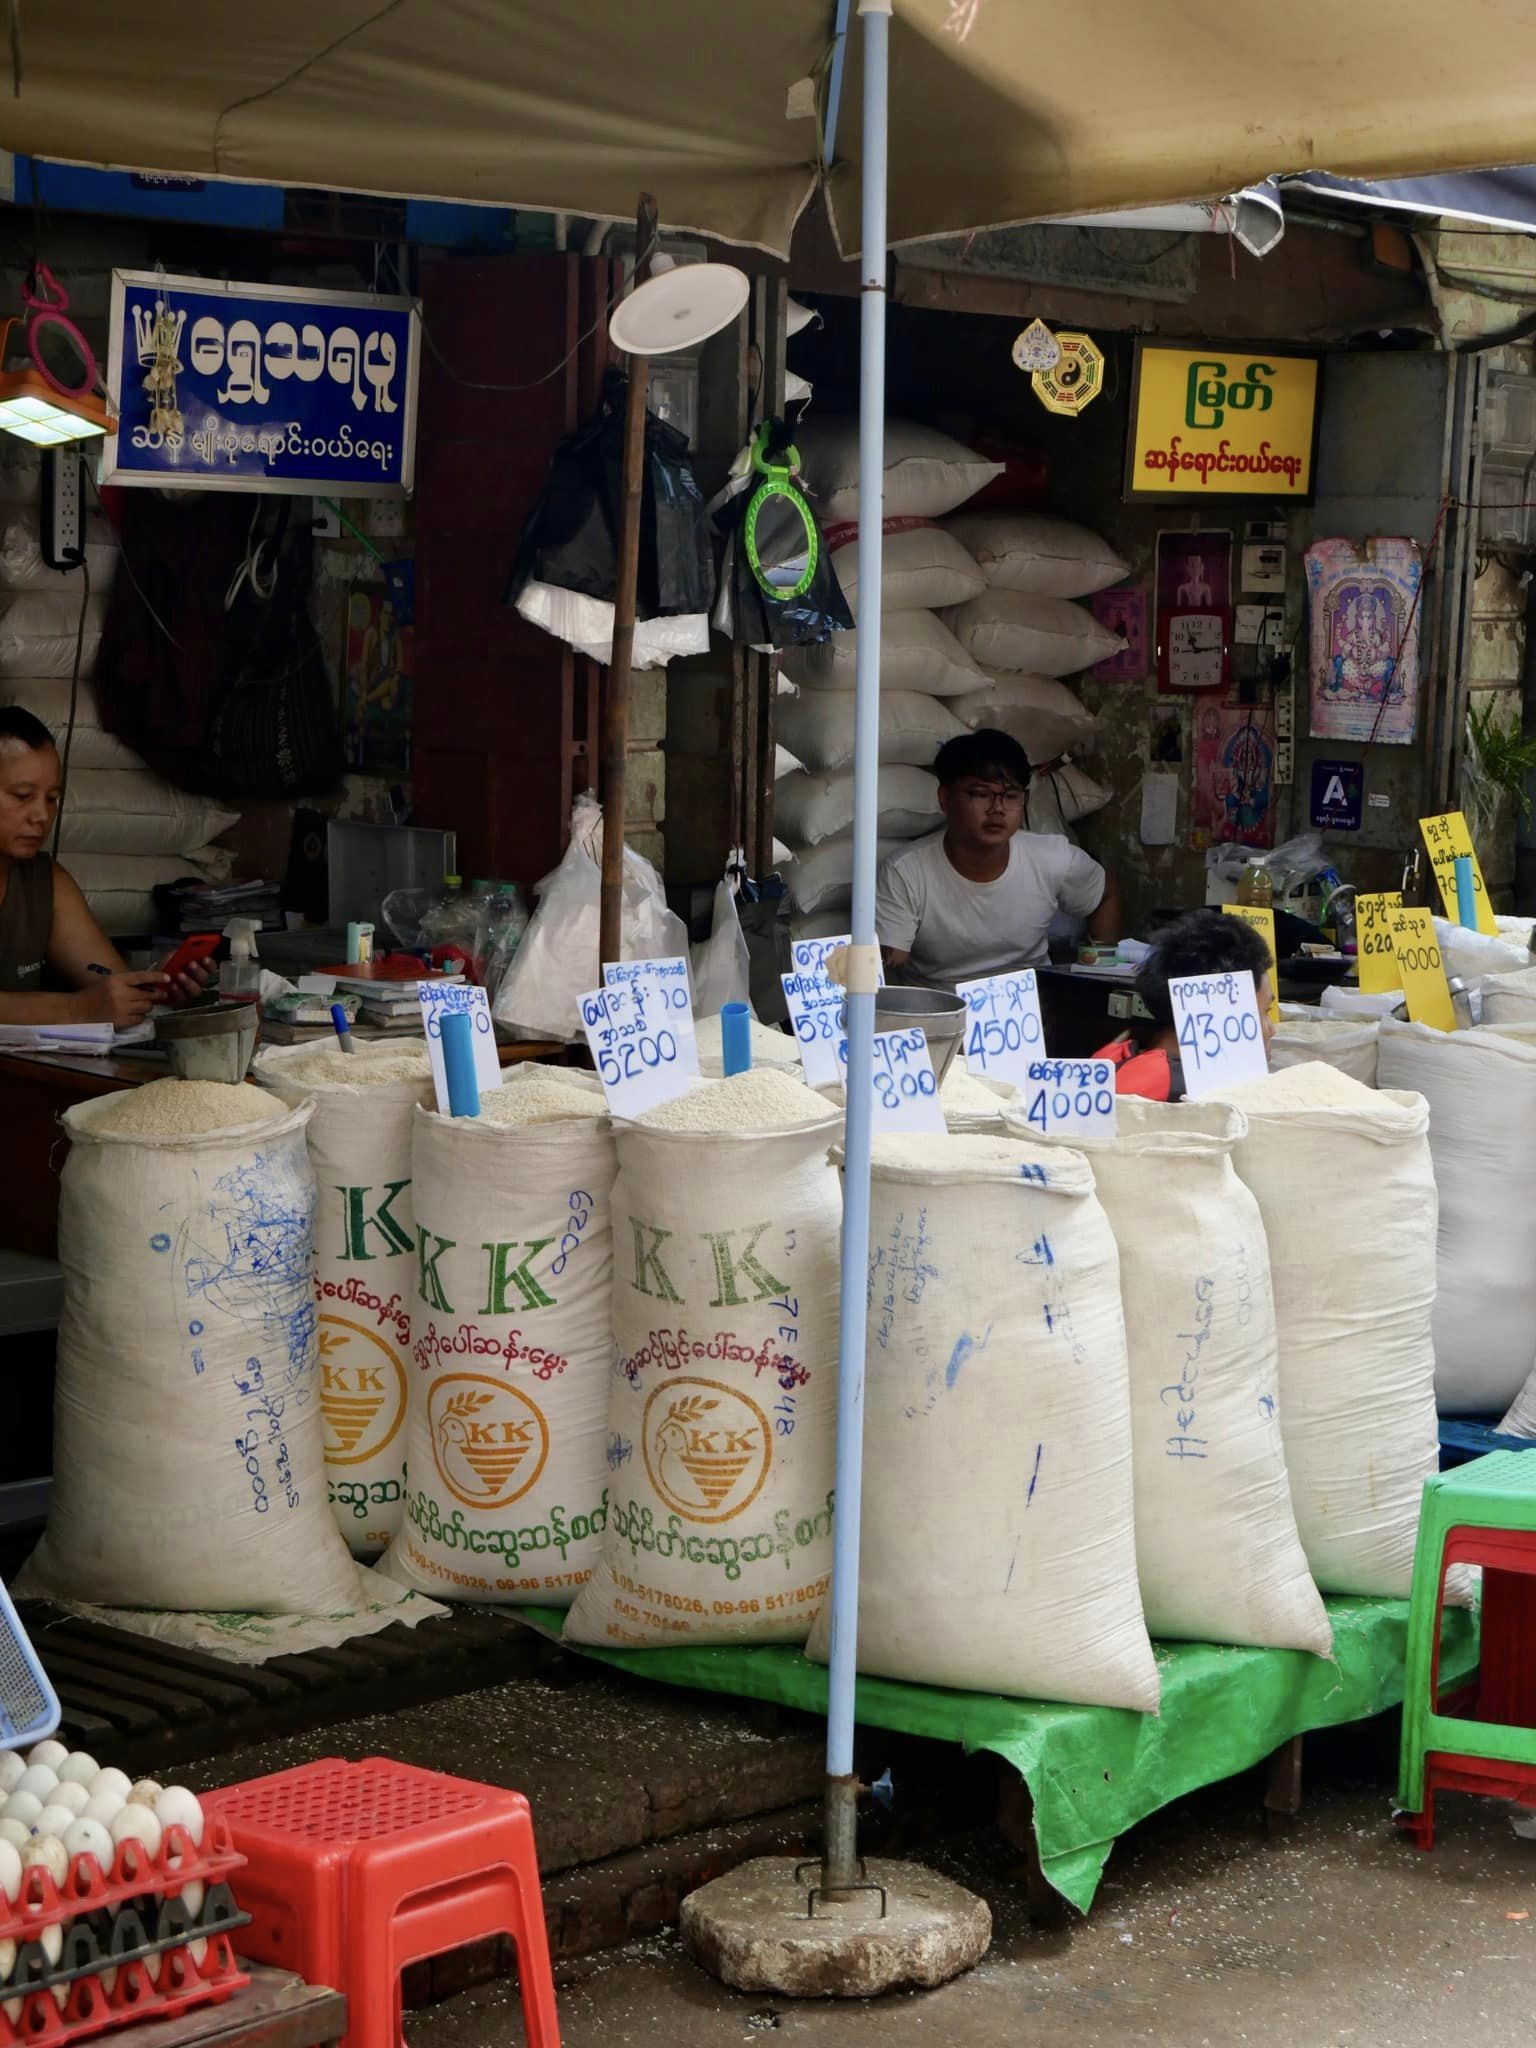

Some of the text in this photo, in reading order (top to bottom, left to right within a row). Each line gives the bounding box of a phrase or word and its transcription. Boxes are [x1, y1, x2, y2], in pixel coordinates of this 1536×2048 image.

[1185, 360, 1276, 430] မြတ်
[1436, 872, 1482, 897] 700
[1363, 932, 1394, 955] 620
[1396, 945, 1441, 973] 4000
[427, 1007, 490, 1039] 60
[968, 1012, 1040, 1071] 4500
[1180, 1012, 1258, 1070] 4300
[598, 1030, 677, 1086] 5200
[873, 1069, 937, 1109] 800
[1028, 1088, 1113, 1132] 4000
